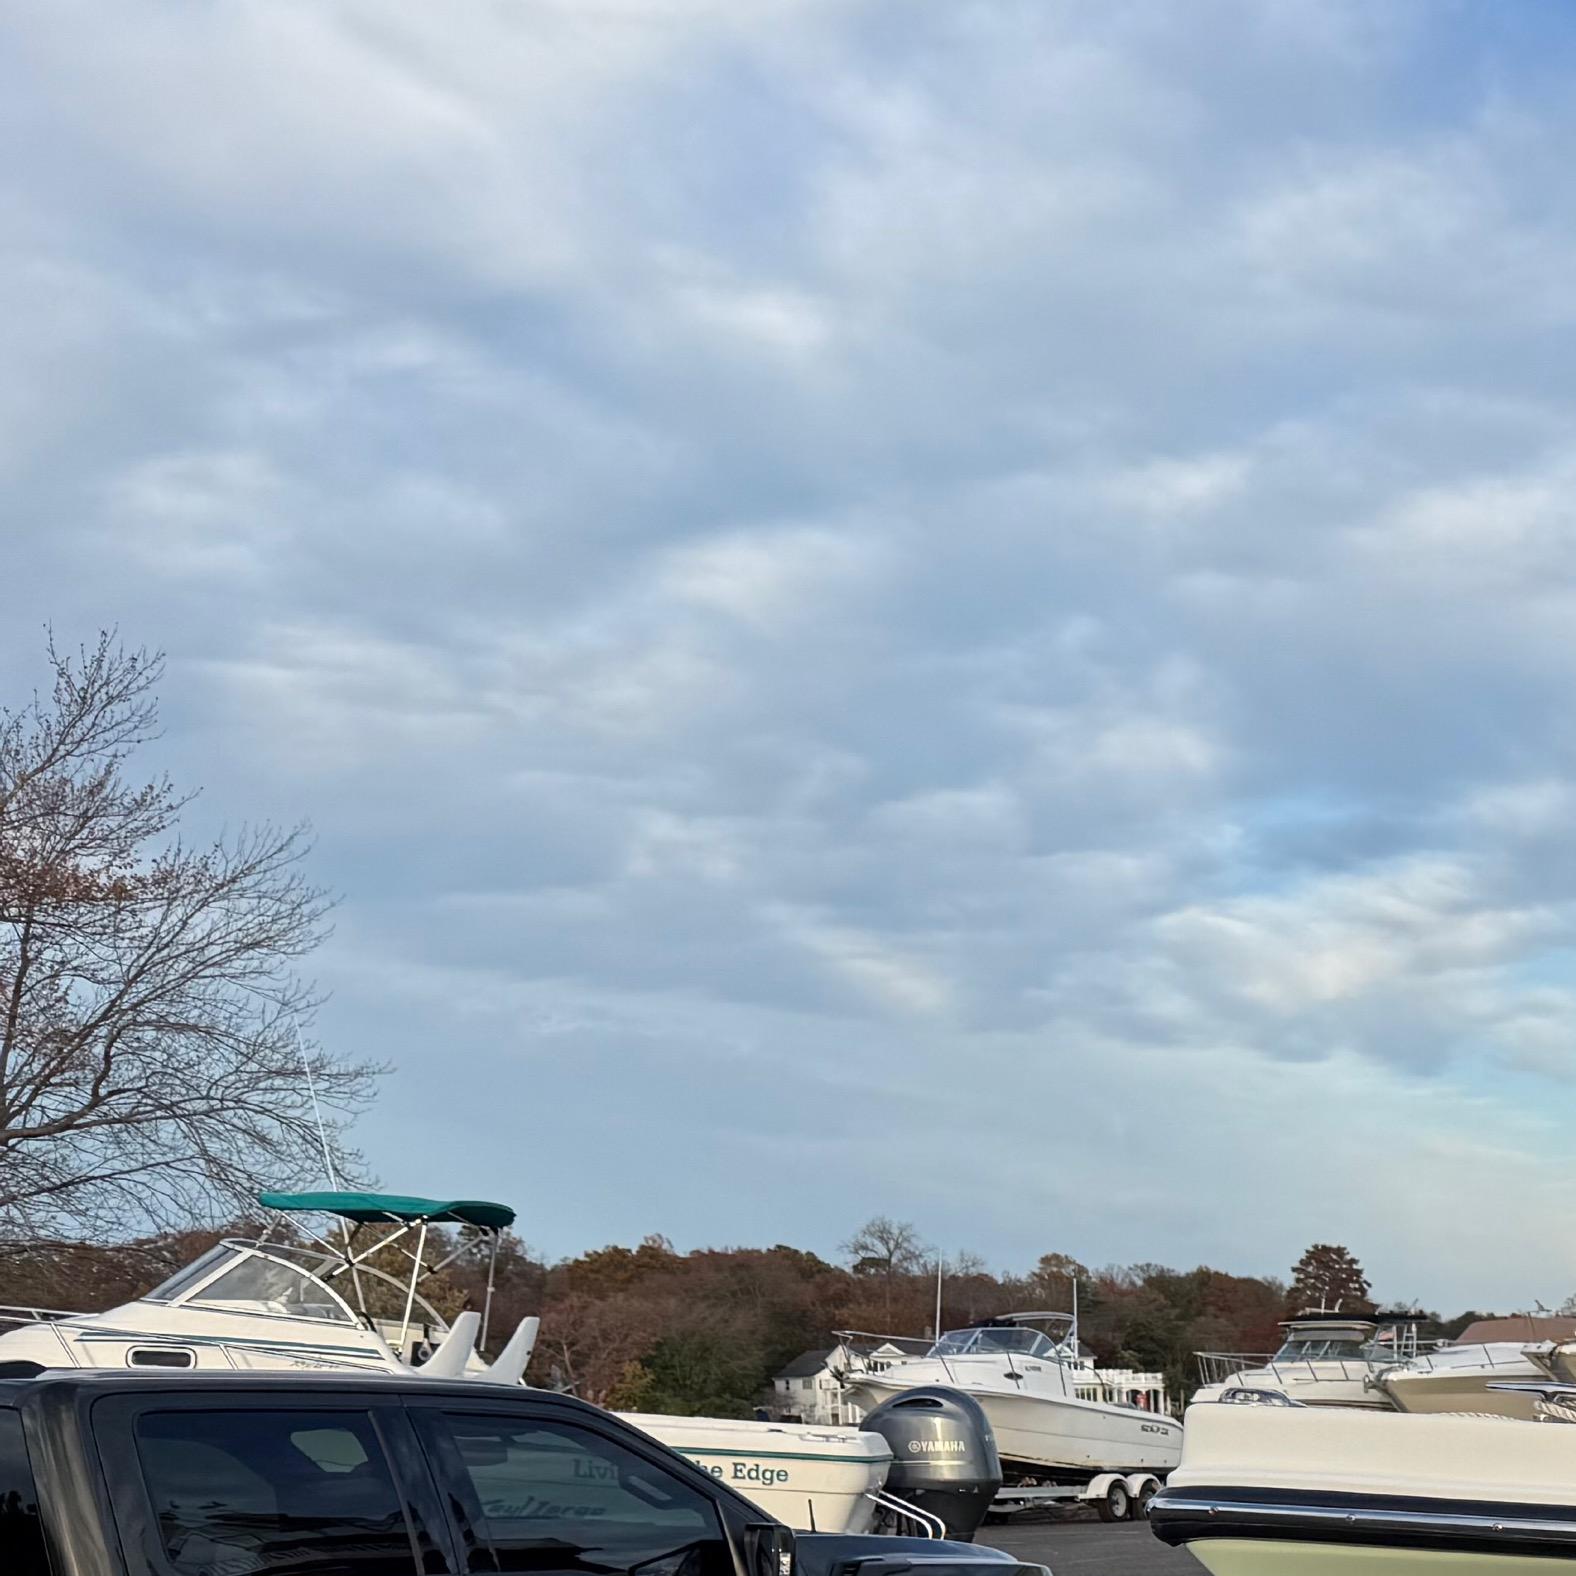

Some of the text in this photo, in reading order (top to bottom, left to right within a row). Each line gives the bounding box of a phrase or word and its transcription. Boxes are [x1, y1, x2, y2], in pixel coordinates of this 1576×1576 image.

[921, 1440, 965, 1452] YAMAHA
[695, 1460, 722, 1478] he
[731, 1462, 789, 1485] Edge
